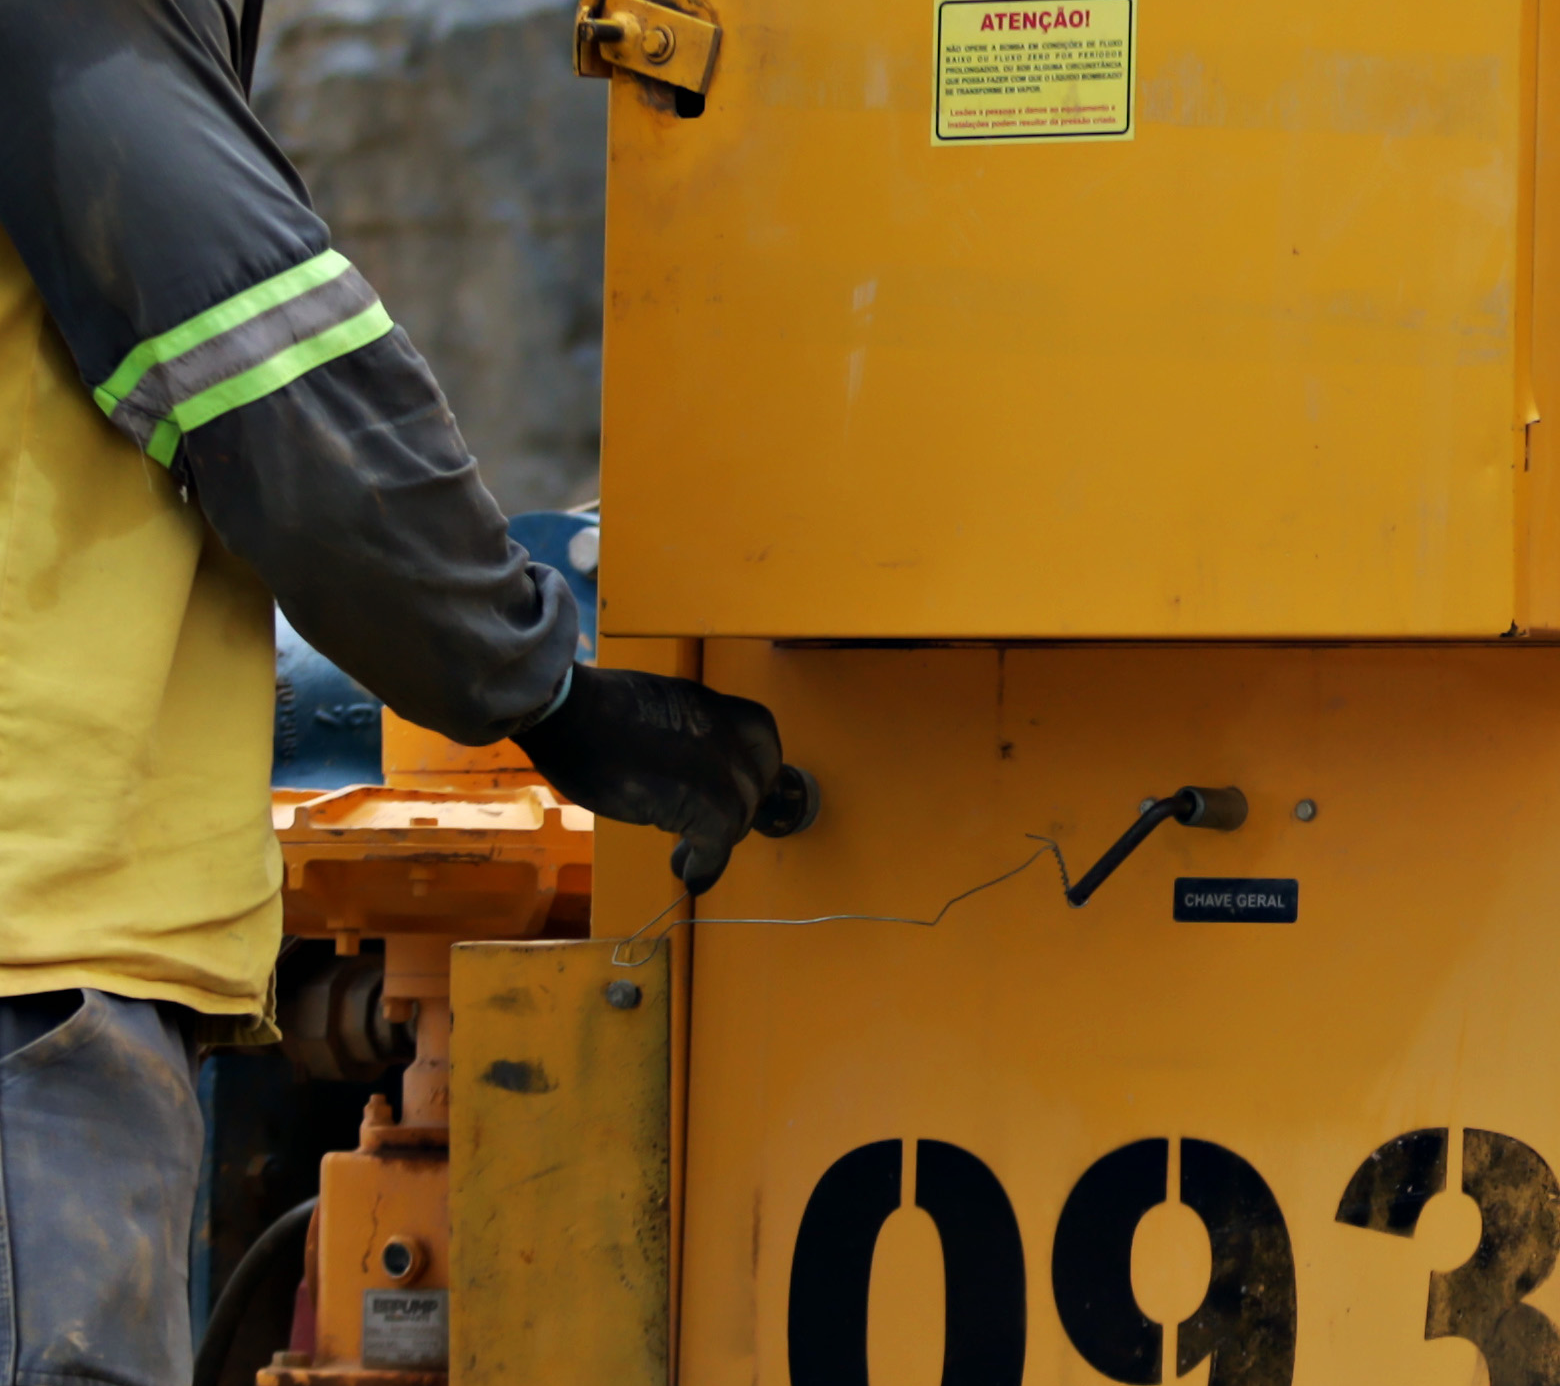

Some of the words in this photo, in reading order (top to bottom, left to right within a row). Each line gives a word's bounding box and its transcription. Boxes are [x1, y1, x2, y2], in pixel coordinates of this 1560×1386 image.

[980, 6, 1091, 33] ATENÇÃO!
[945, 44, 961, 53] NÃO
[964, 44, 987, 52] OPERE
[1000, 43, 1025, 51] BOMBA
[1028, 42, 1039, 50] EM
[1042, 39, 1083, 50] CONDIÇÕES
[1086, 40, 1095, 48] DE
[1099, 39, 1122, 47] FLUXO
[977, 55, 989, 63] OU
[994, 54, 1022, 62] FLUXO
[1027, 53, 1050, 61] ZERO
[1055, 52, 1073, 60] POR
[1003, 65, 1014, 73] OU
[1017, 64, 1031, 72] SOB
[1034, 63, 1063, 71] ALGUMA
[1065, 61, 1122, 70] CIRCUNSTÂNCIA
[1051, 73, 1080, 82] LÍQUIDO
[956, 87, 1002, 95] TRANSFORME
[1005, 86, 1015, 94] EM
[1184, 893, 1232, 908] CHAVE
[1235, 893, 1285, 909] GERAL
